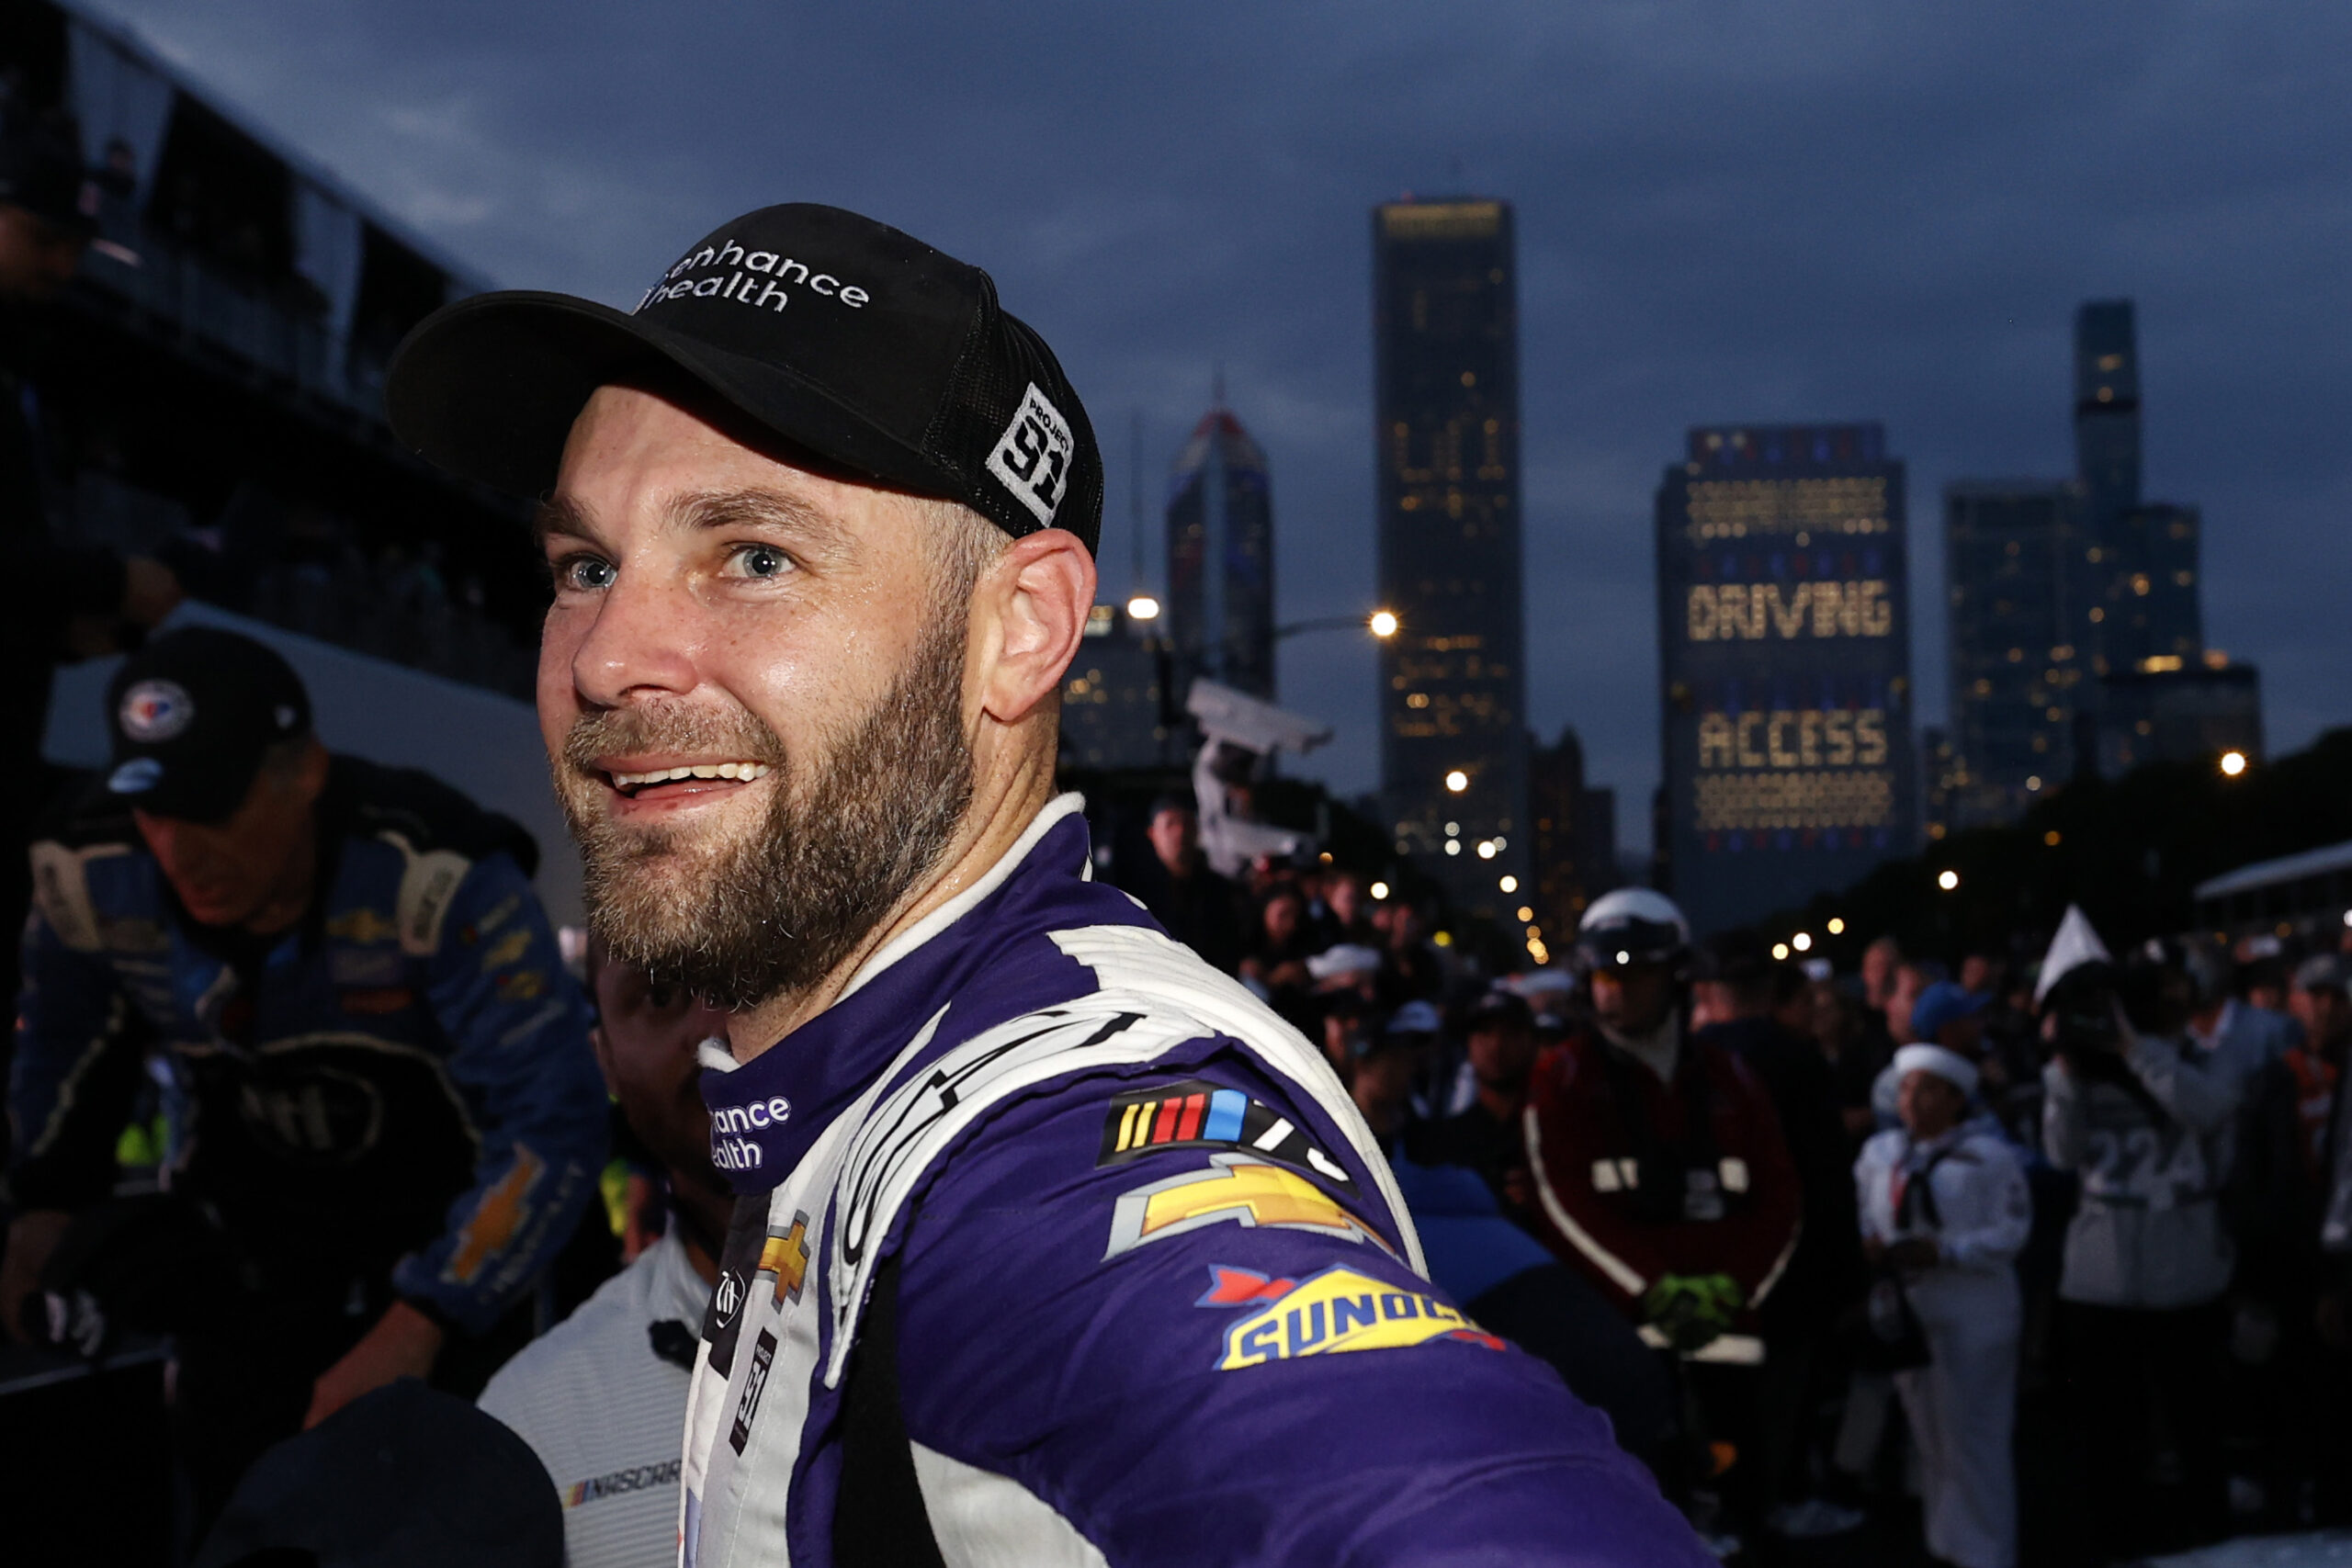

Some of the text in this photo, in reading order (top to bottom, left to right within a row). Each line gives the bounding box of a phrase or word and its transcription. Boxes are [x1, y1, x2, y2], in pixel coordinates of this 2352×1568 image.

[643, 271, 788, 313] health
[670, 239, 870, 309] enhance
[1030, 398, 1069, 454] PROJECT
[1002, 415, 1063, 510] 91
[1689, 581, 1891, 640] DRIVING
[1699, 709, 1888, 768] ACCESS
[711, 1097, 790, 1134] ance
[1240, 1292, 1461, 1360] SUNOC
